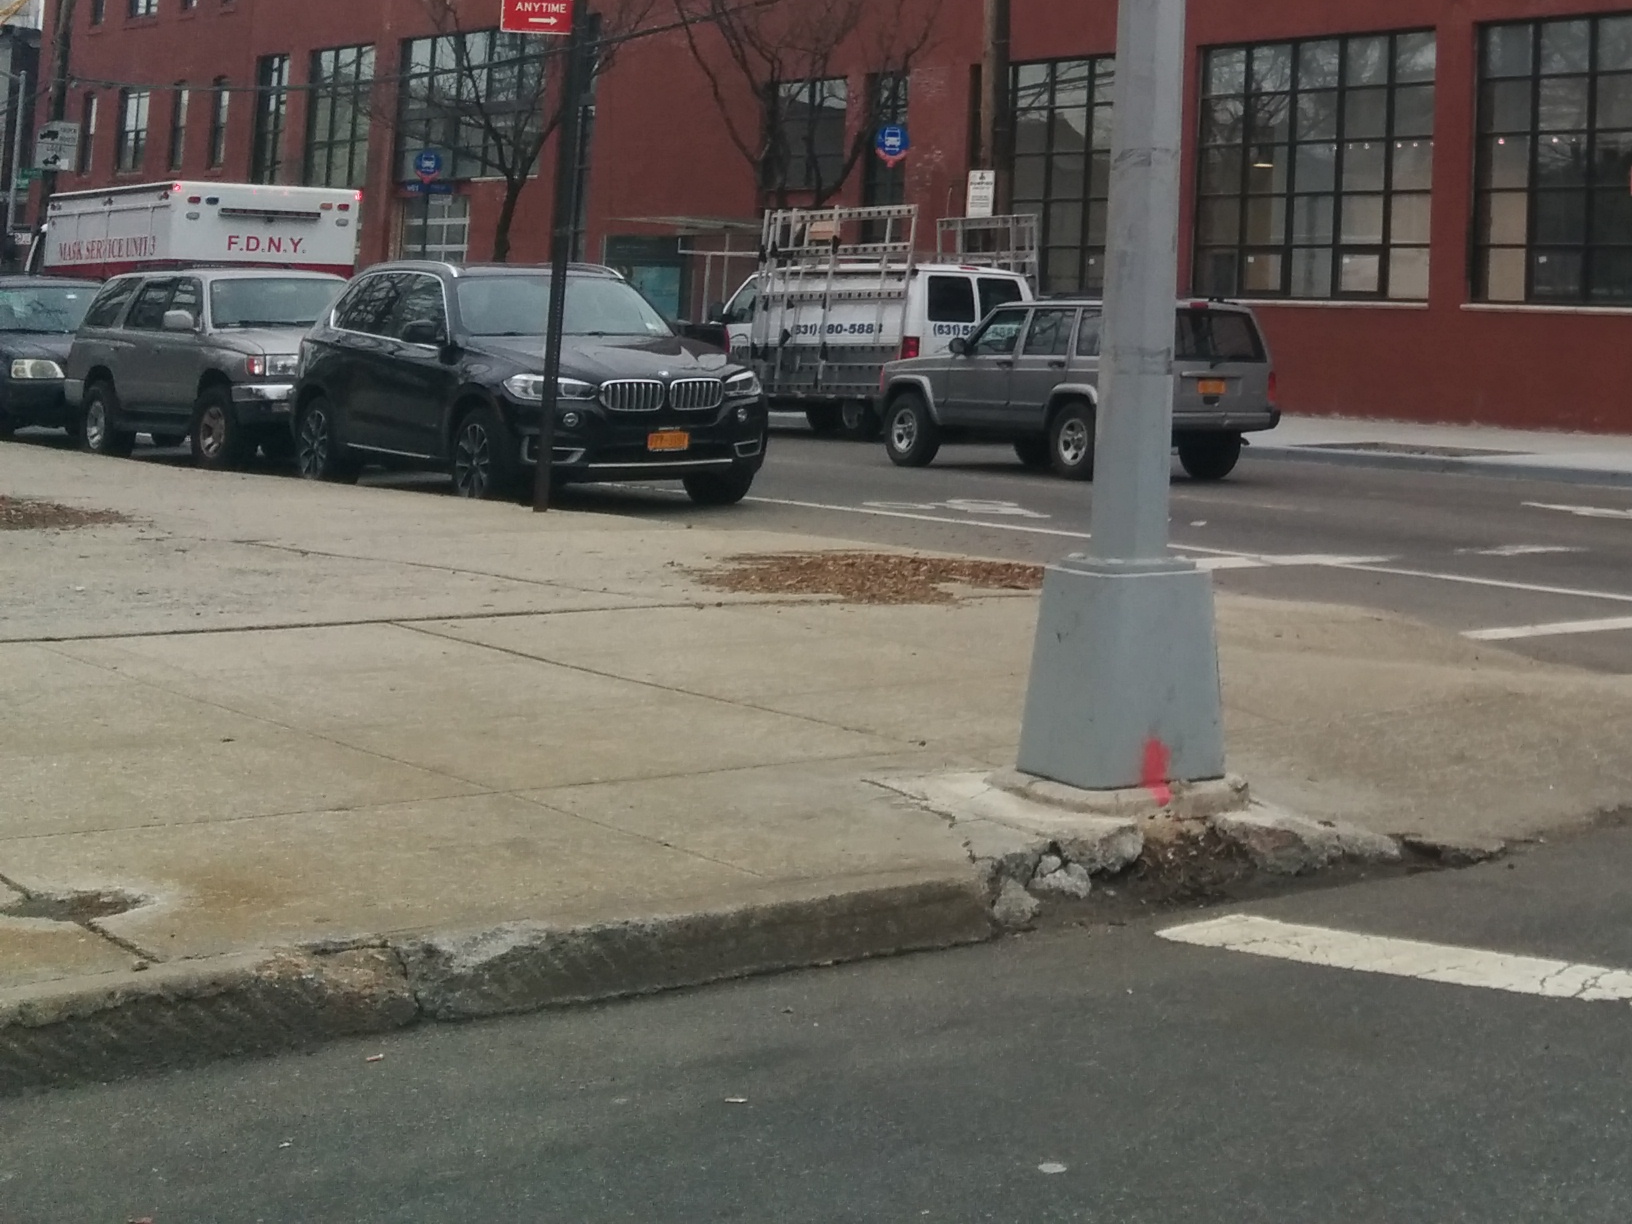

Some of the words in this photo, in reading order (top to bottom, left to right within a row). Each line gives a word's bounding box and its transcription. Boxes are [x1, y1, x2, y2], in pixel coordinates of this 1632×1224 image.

[515, 2, 567, 14] ANYTIME
[58, 241, 83, 261] MASK
[86, 238, 124, 259] SERVICE
[126, 236, 149, 257] UNIT
[149, 235, 157, 256] 3
[227, 235, 307, 254] F.D.N.Y.
